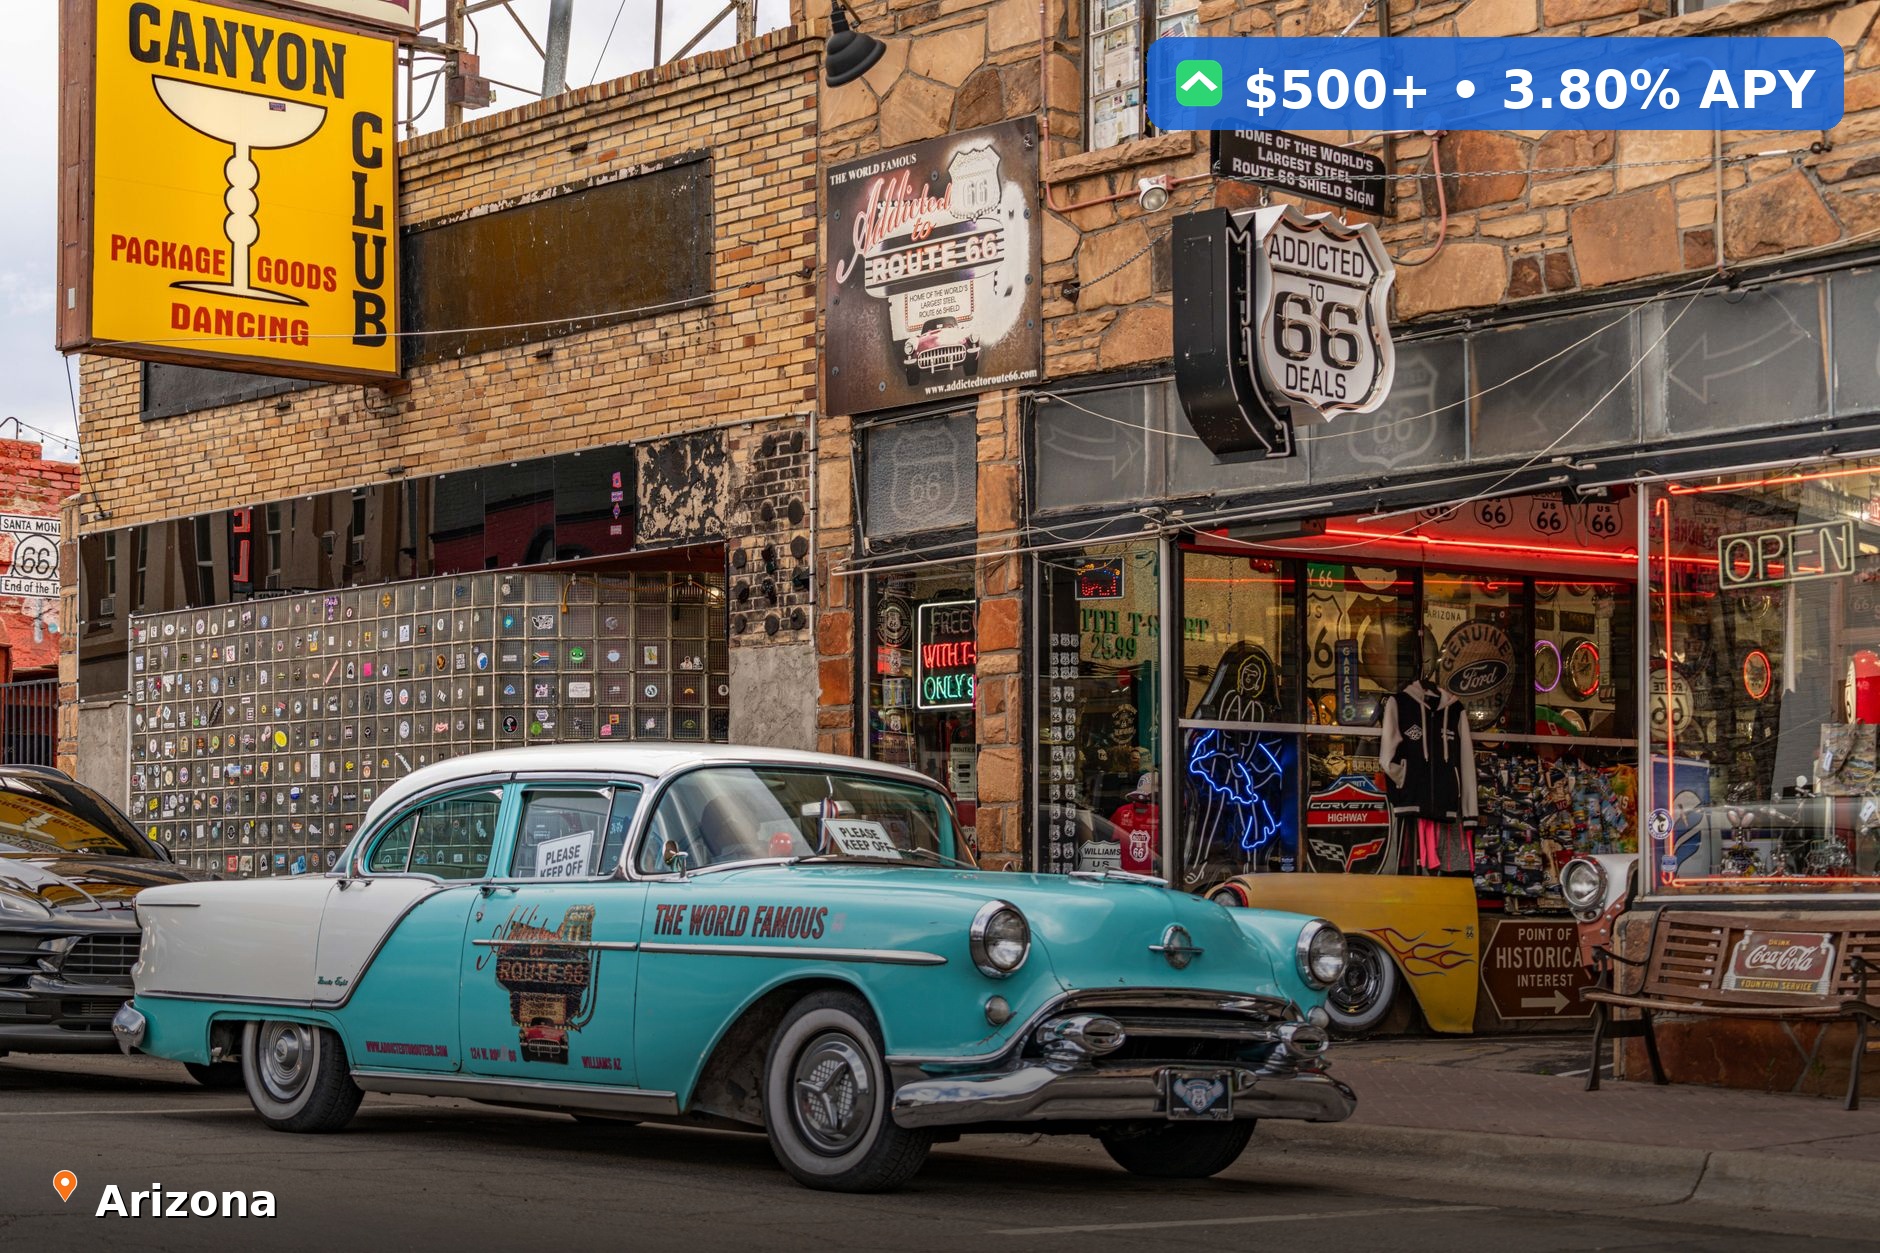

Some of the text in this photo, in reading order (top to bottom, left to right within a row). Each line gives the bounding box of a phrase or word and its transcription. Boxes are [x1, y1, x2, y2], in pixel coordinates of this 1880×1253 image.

[129, 2, 346, 100] CANYON
[1235, 123, 1374, 172] HOME OF THE WORLD'S
[830, 153, 917, 187] THE WORLD FAMOUS
[1258, 147, 1352, 184] LARGEST STEEL
[1232, 157, 1375, 207] ROUTE 66 SHIELD SIGN
[352, 111, 387, 348] CLUB
[836, 169, 953, 285] Addicted
[911, 221, 936, 241] to
[111, 233, 338, 293] PACKAGE GOODS
[871, 233, 999, 284] ROUTE 66
[1269, 233, 1365, 278] ADDICTED
[910, 284, 969, 302] HOME OF THE WORLD'S
[921, 296, 957, 309] LARGEST STEEL
[1308, 283, 1325, 303] TO
[919, 304, 960, 318] ROUTE 66 SHIELD
[170, 302, 310, 347] DANCING
[1273, 290, 1363, 371] 66
[925, 369, 1038, 395] www.addictedtoroute66.com
[1286, 363, 1347, 400] DEALS
[1482, 504, 1506, 524] 66
[1542, 502, 1556, 510] US
[1597, 505, 1611, 513] US
[3, 518, 32, 531] SANTA
[1536, 511, 1561, 530] 66
[1592, 514, 1616, 534] 66
[21, 547, 50, 576] 66
[1725, 525, 1848, 582] OPEN
[4, 580, 22, 593] End
[24, 581, 34, 593] of
[35, 582, 50, 595] the
[1319, 570, 1333, 588] 66
[933, 609, 972, 636] FREE
[1081, 608, 1120, 635] ITH
[1427, 610, 1461, 621] ARIZONA
[923, 643, 960, 668] WITH
[1443, 625, 1511, 671] GENUINE
[1342, 646, 1351, 704] GARAGE
[1460, 664, 1498, 691] Ford
[924, 673, 966, 700] ONLY
[1327, 812, 1368, 822] HIGHWAY
[839, 827, 881, 840] PLEASE
[545, 844, 581, 865] PLEASE
[841, 838, 895, 853] KEEP OFF
[1084, 847, 1121, 856] WILLIAMS
[1133, 847, 1143, 858] 66
[565, 860, 584, 877] OFF
[654, 904, 828, 940] THE WORLD FAMOUS
[1518, 928, 1573, 941] POINT OF
[1768, 938, 1791, 946] DRINK
[1496, 946, 1583, 968] HISTORICA
[1745, 944, 1821, 971] Coca-Cola
[500, 961, 585, 983] ROUTE 66
[1517, 974, 1574, 987] INTEREST
[1740, 979, 1813, 992] FOUNTAIN SERVICE
[581, 1056, 613, 1070] WILLIAMS
